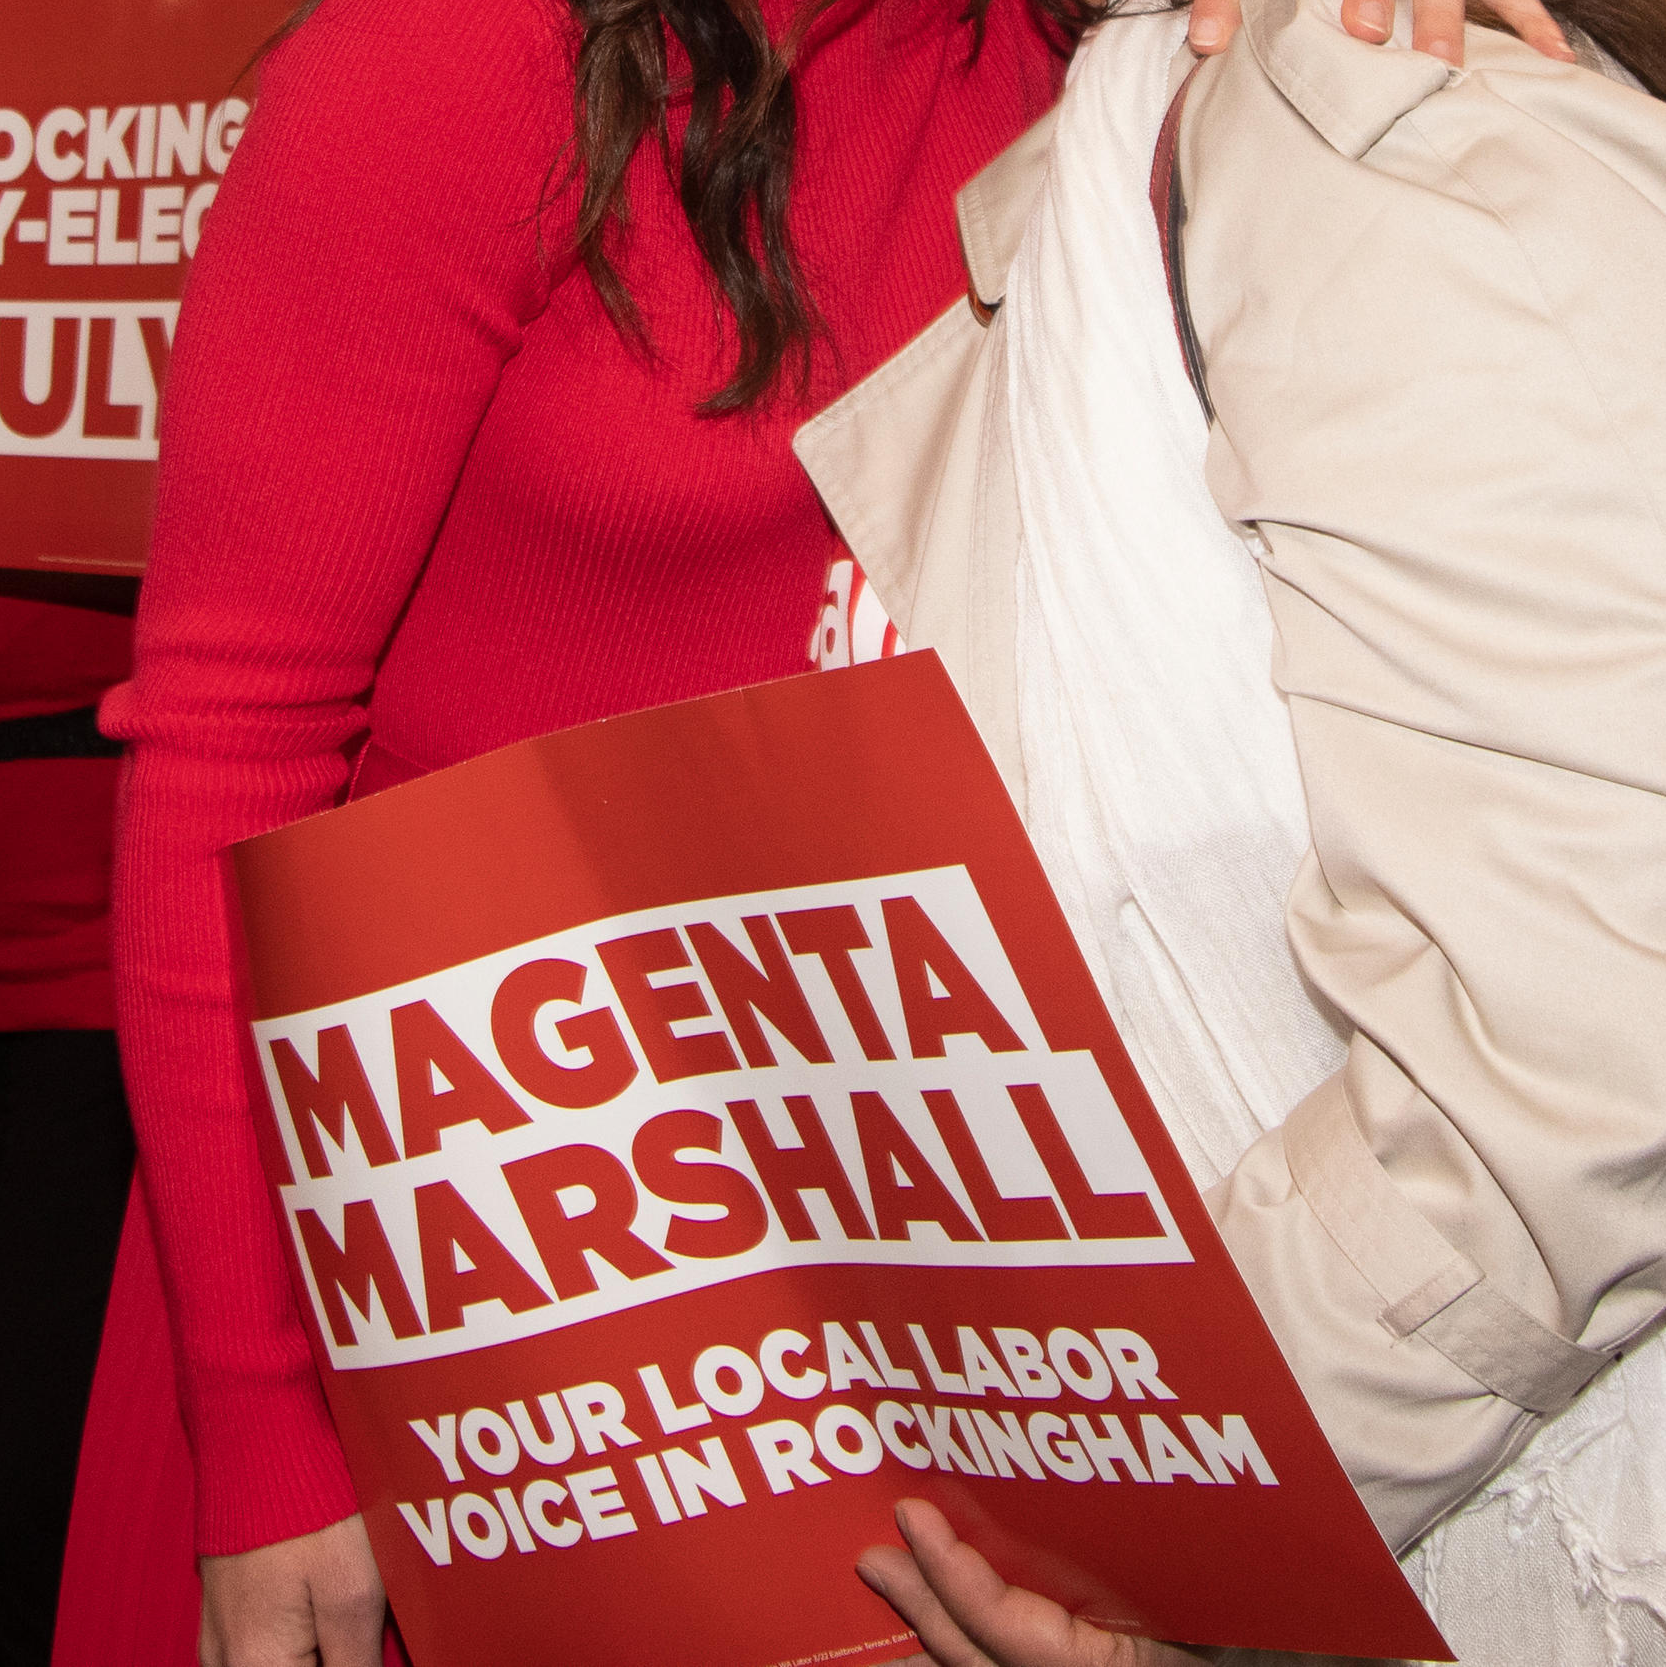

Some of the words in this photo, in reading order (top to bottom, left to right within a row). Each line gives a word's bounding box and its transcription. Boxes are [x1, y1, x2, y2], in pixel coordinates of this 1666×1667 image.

[268, 895, 1027, 1185] MAGENTA
[291, 1083, 1167, 1347] MARSHALL
[396, 1466, 637, 1567] VOICE
[646, 1436, 747, 1528] IN
[745, 1405, 1280, 1498] ROCKINGHAM
[409, 1379, 642, 1486] YOUR
[637, 1323, 929, 1436] LOCAL
[930, 1325, 1178, 1402] LABOR
